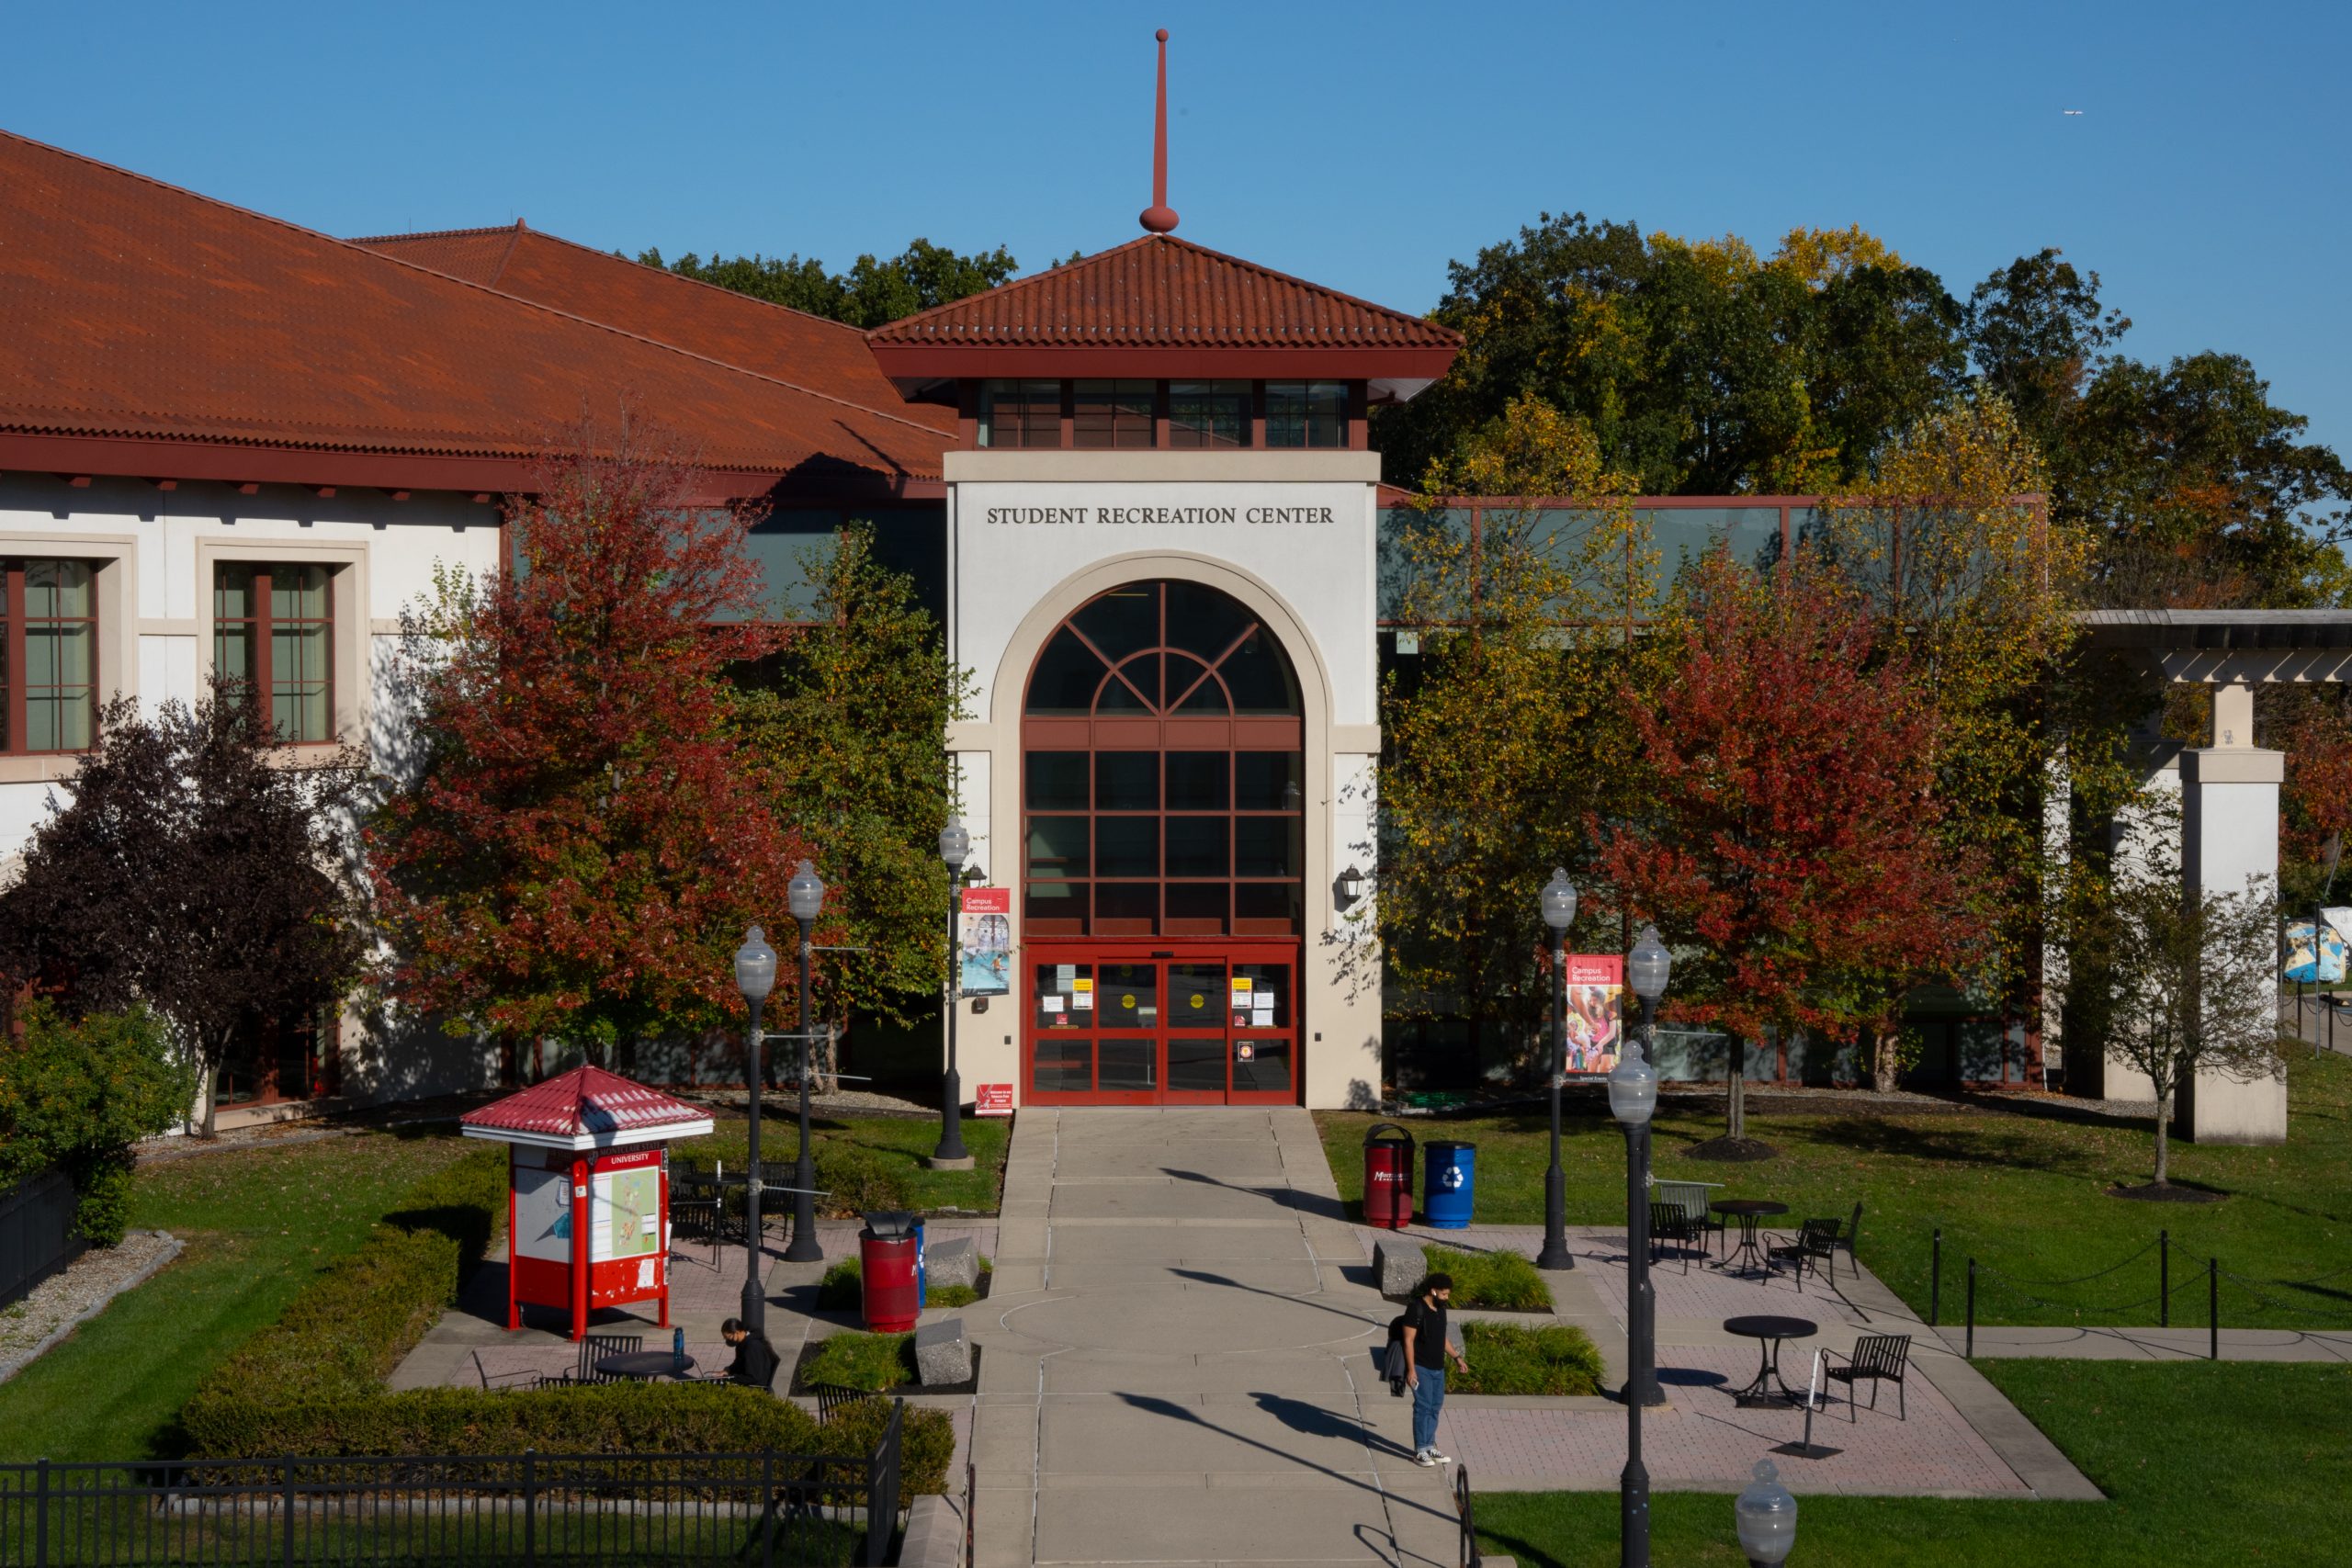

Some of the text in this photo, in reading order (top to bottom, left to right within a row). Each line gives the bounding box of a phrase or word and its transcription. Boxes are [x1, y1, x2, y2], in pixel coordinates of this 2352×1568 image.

[987, 507, 1334, 524] STUDENT RECREATION CENTER
[1572, 967, 1601, 976] Campus
[611, 1153, 650, 1165] UNIVERSITY
